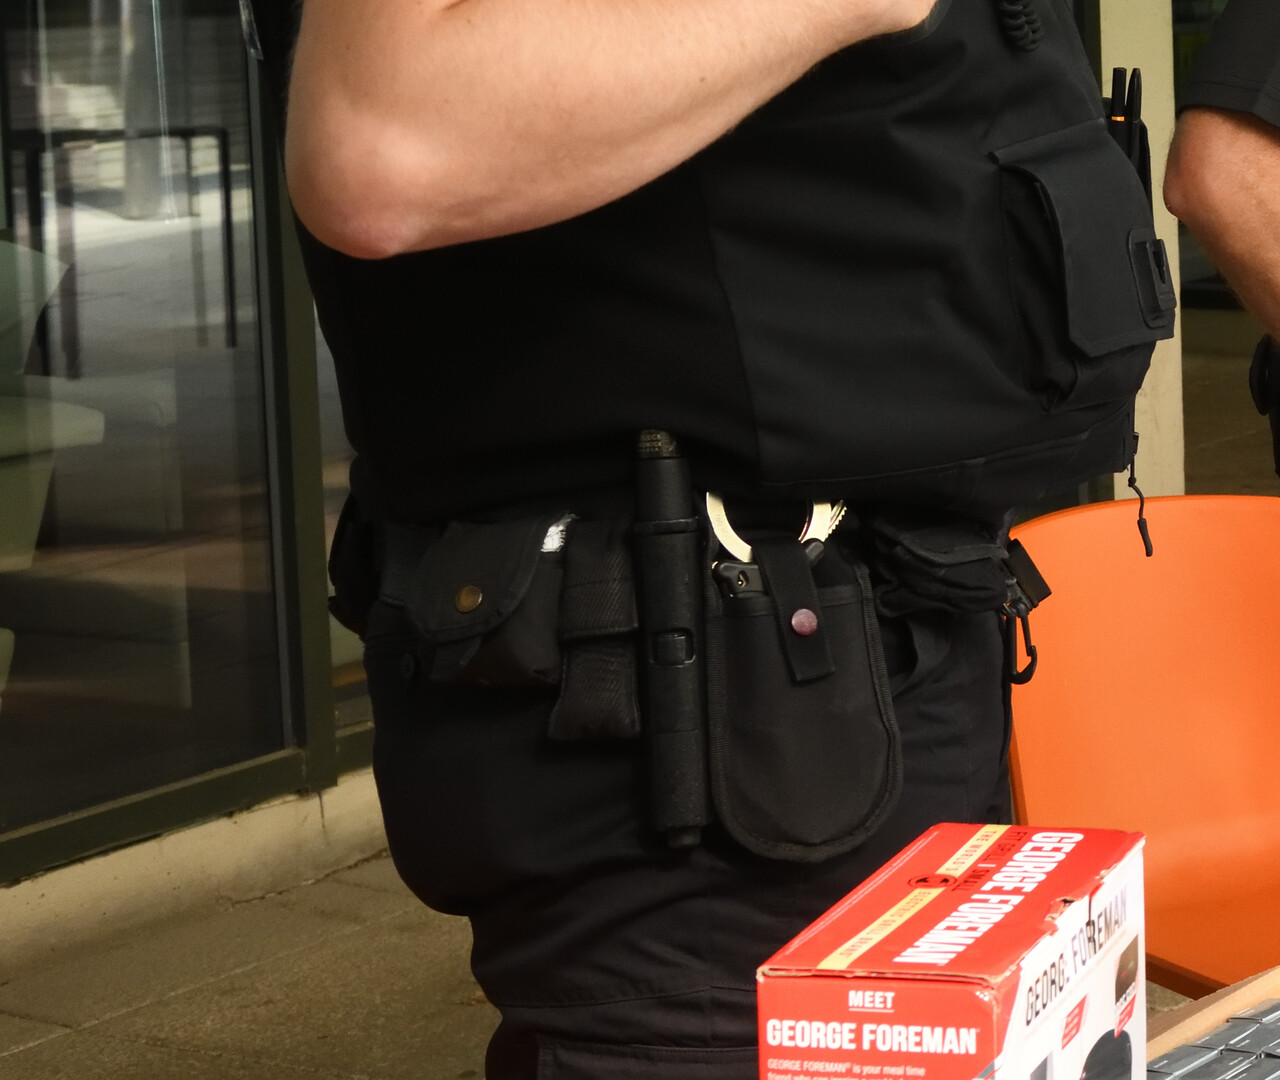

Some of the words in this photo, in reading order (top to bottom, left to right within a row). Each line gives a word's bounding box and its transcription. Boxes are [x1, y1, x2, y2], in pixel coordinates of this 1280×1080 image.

[980, 832, 1084, 892] GEORGE
[892, 894, 1025, 965] FOREMAN
[848, 990, 895, 1008] MEET
[767, 1019, 858, 1051] GEORGE
[862, 1024, 977, 1055] FOREMAN
[768, 1058, 801, 1070] GEORGE
[853, 1063, 860, 1074] is
[862, 1066, 881, 1076] your
[883, 1065, 904, 1075] meal
[906, 1065, 925, 1076] time
